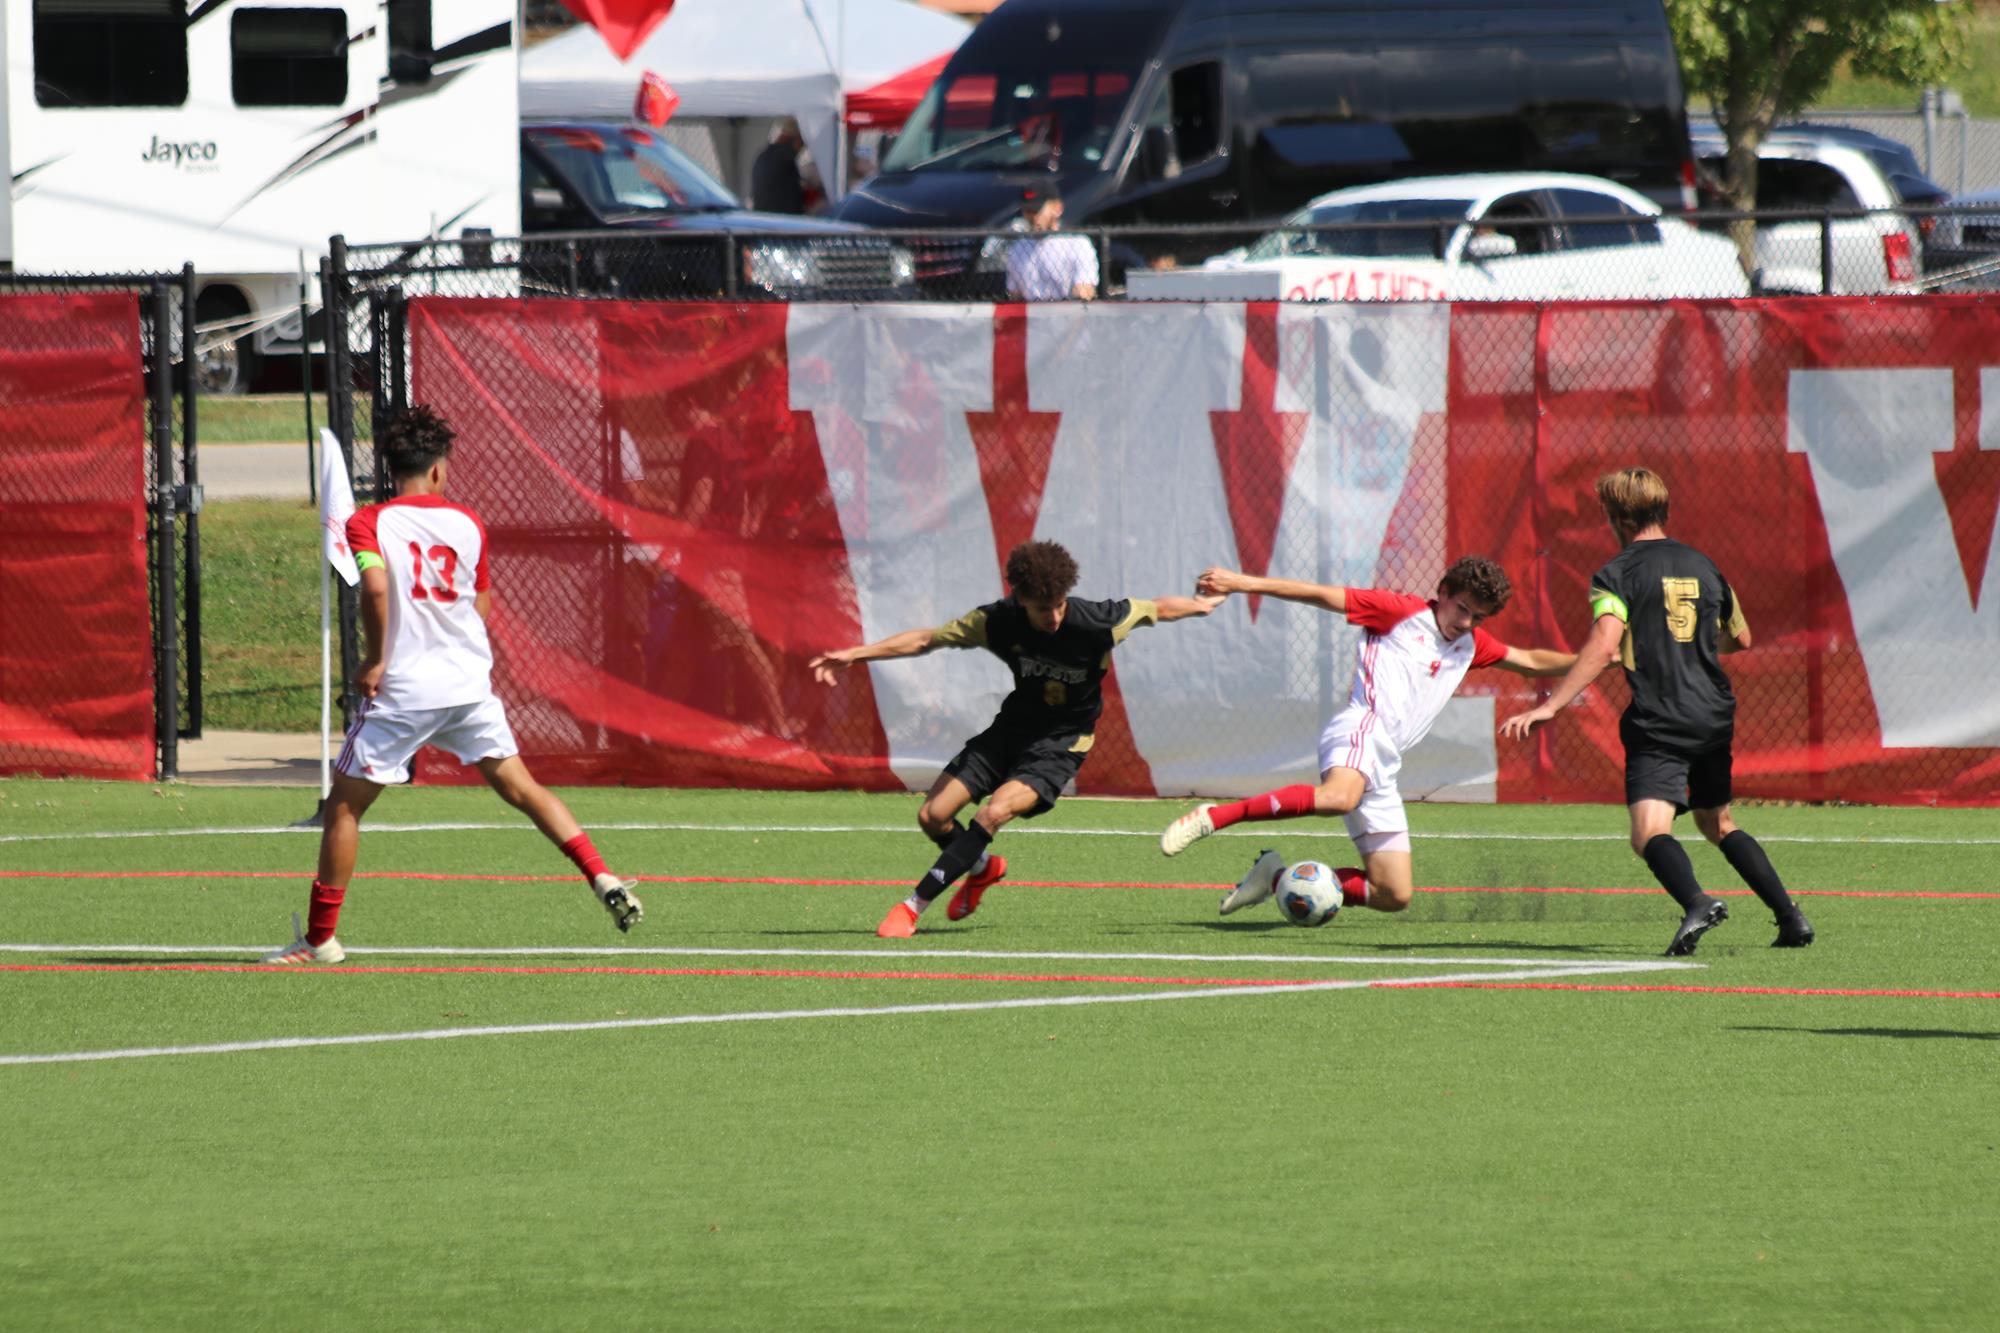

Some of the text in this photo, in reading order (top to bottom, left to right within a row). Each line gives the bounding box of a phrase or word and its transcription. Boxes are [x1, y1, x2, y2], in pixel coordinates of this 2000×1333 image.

[142, 135, 217, 168] Jayco
[408, 541, 459, 603] 13
[1662, 576, 1699, 642] 5
